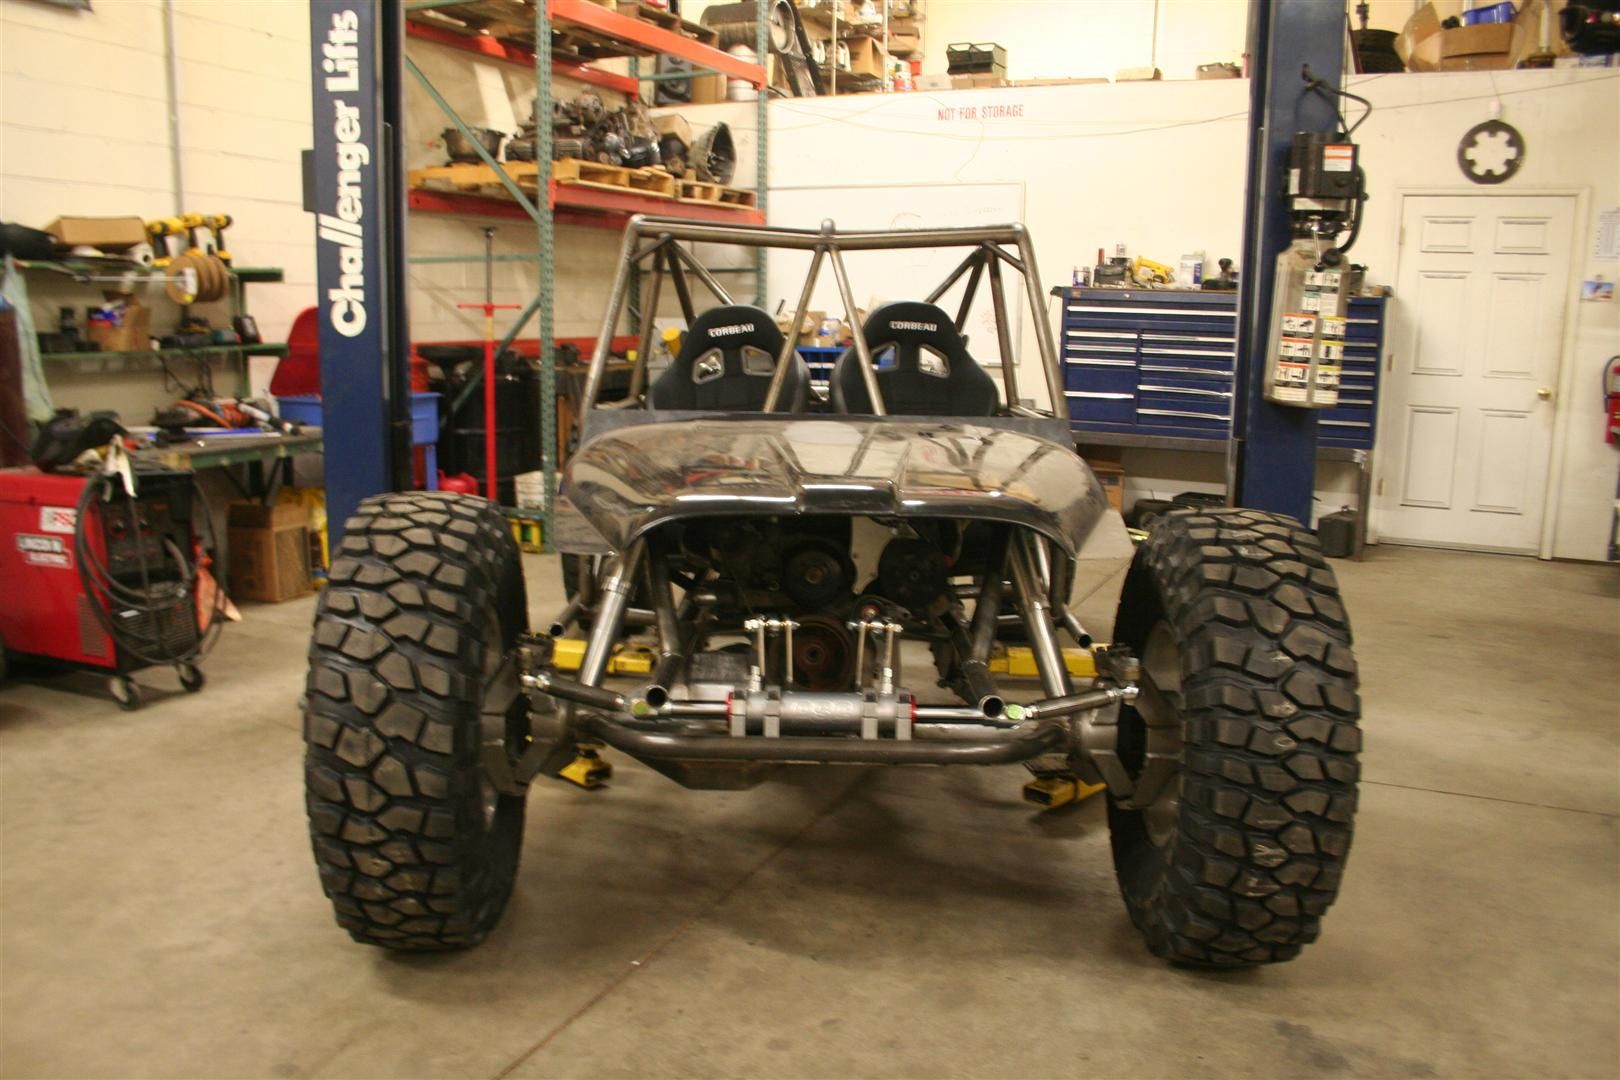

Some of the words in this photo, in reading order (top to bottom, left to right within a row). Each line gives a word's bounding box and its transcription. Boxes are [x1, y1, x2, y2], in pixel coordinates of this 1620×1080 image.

[322, 9, 360, 92] Lifts
[937, 107, 956, 121] NOT
[959, 106, 977, 120] FOR
[981, 104, 1025, 119] STORAGE
[319, 99, 370, 338] Challenger
[708, 322, 755, 338] CORBEAU
[888, 320, 938, 332] CORBEAU
